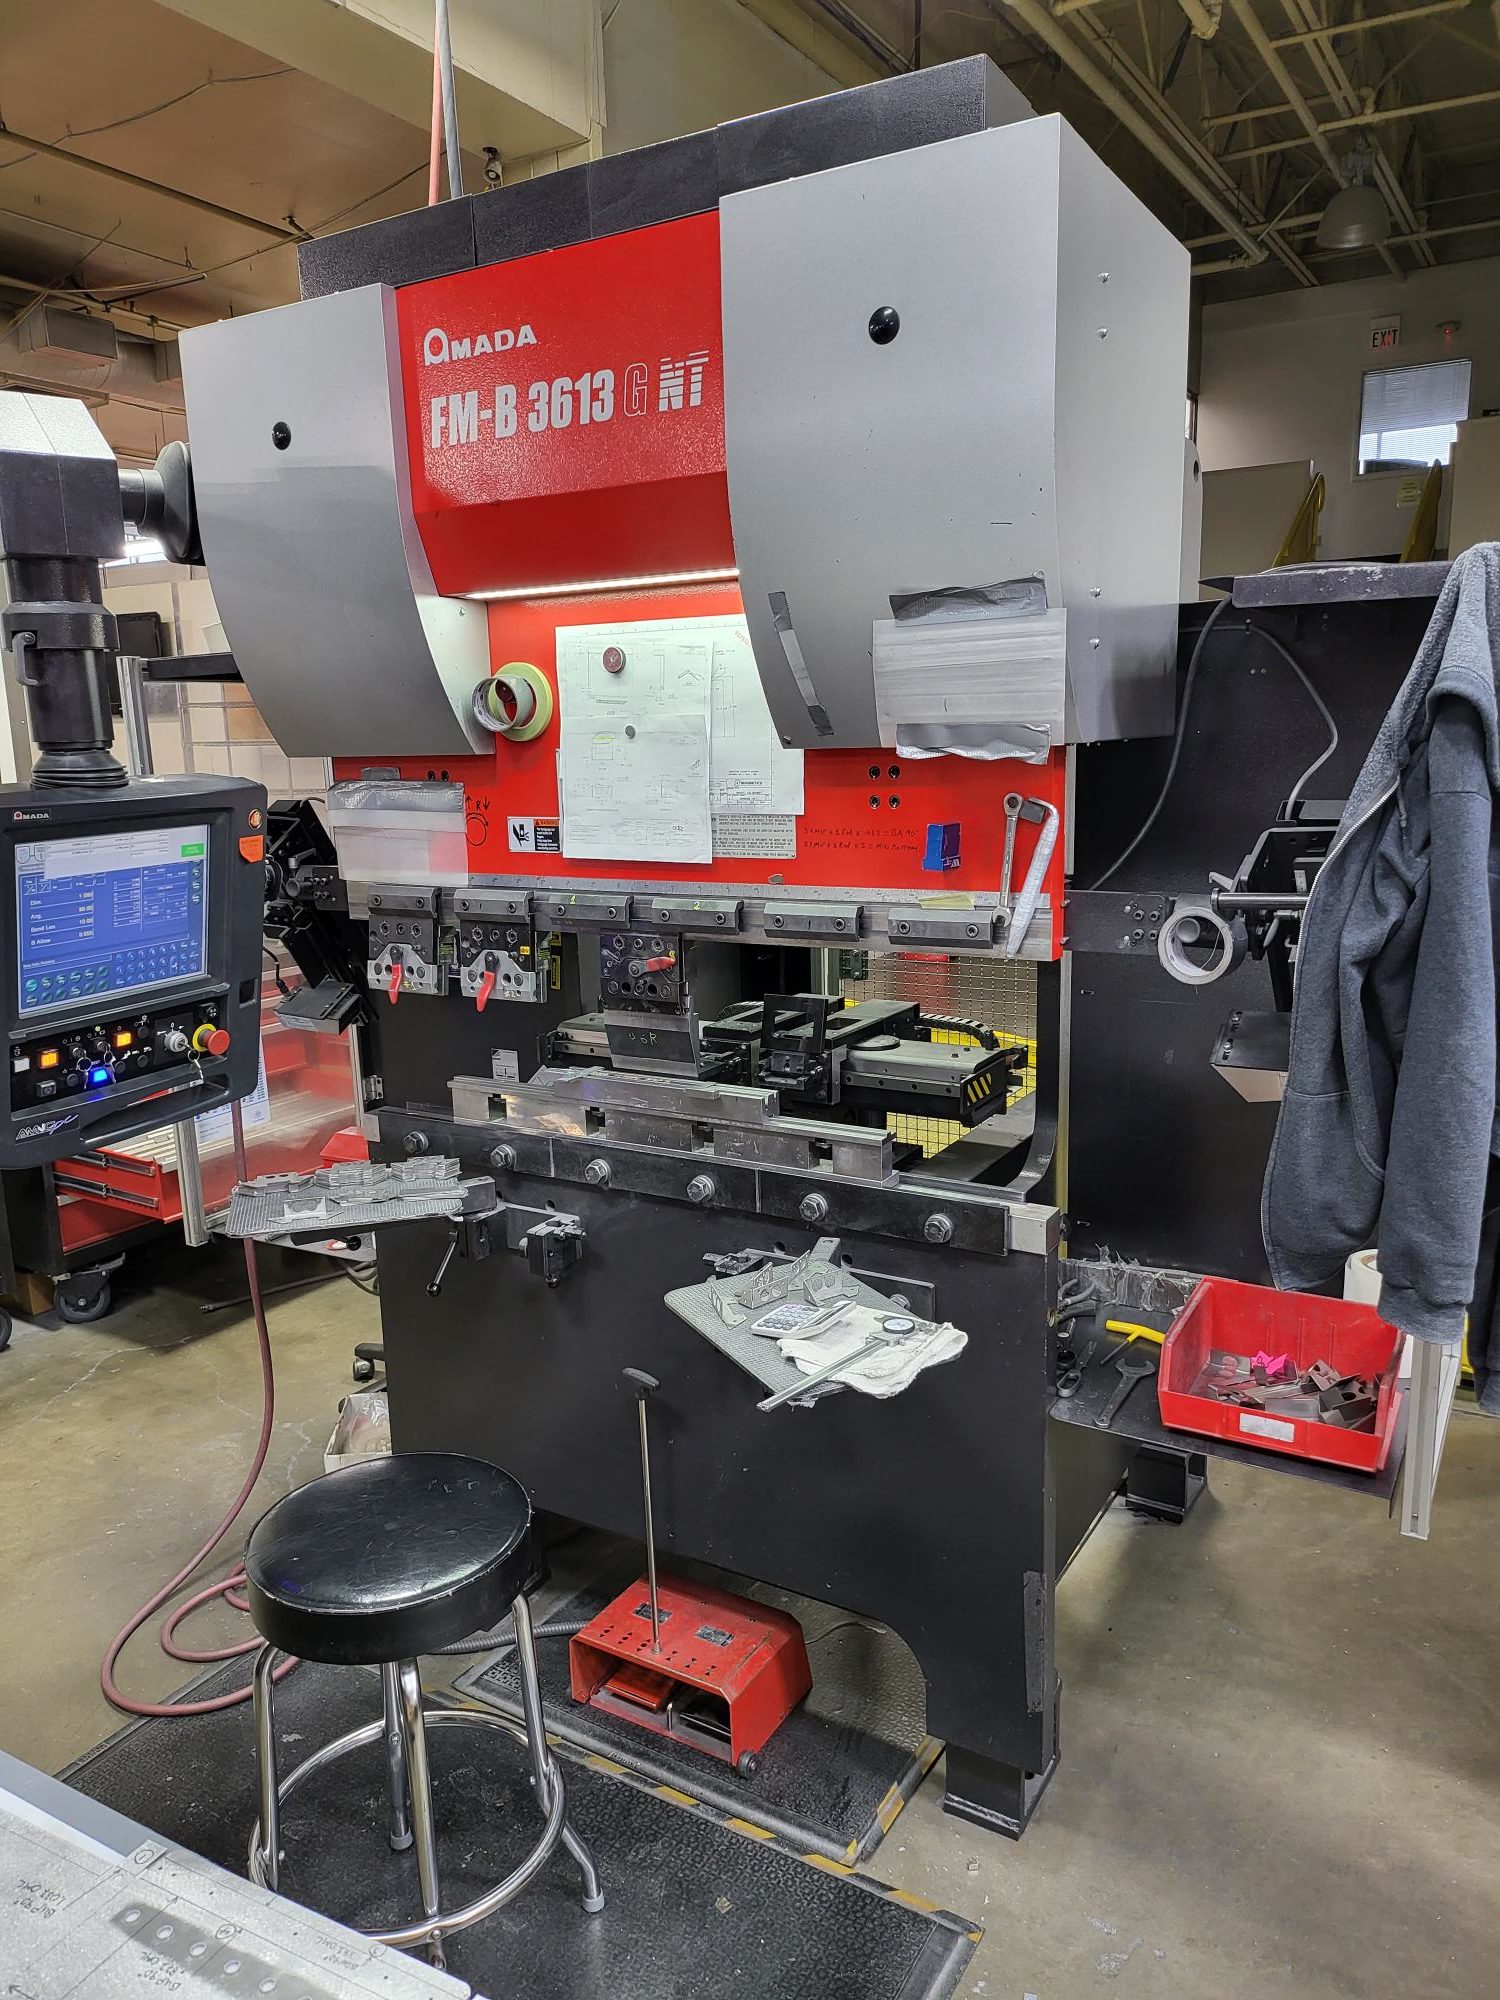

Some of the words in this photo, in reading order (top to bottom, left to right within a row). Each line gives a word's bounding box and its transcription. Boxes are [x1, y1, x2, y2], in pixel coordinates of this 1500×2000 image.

[424, 324, 537, 366] AMADA
[1372, 329, 1398, 348] EXIT
[431, 383, 518, 449] FM-B
[528, 368, 615, 433] 3613
[624, 362, 648, 417] G
[693, 901, 700, 911] 2
